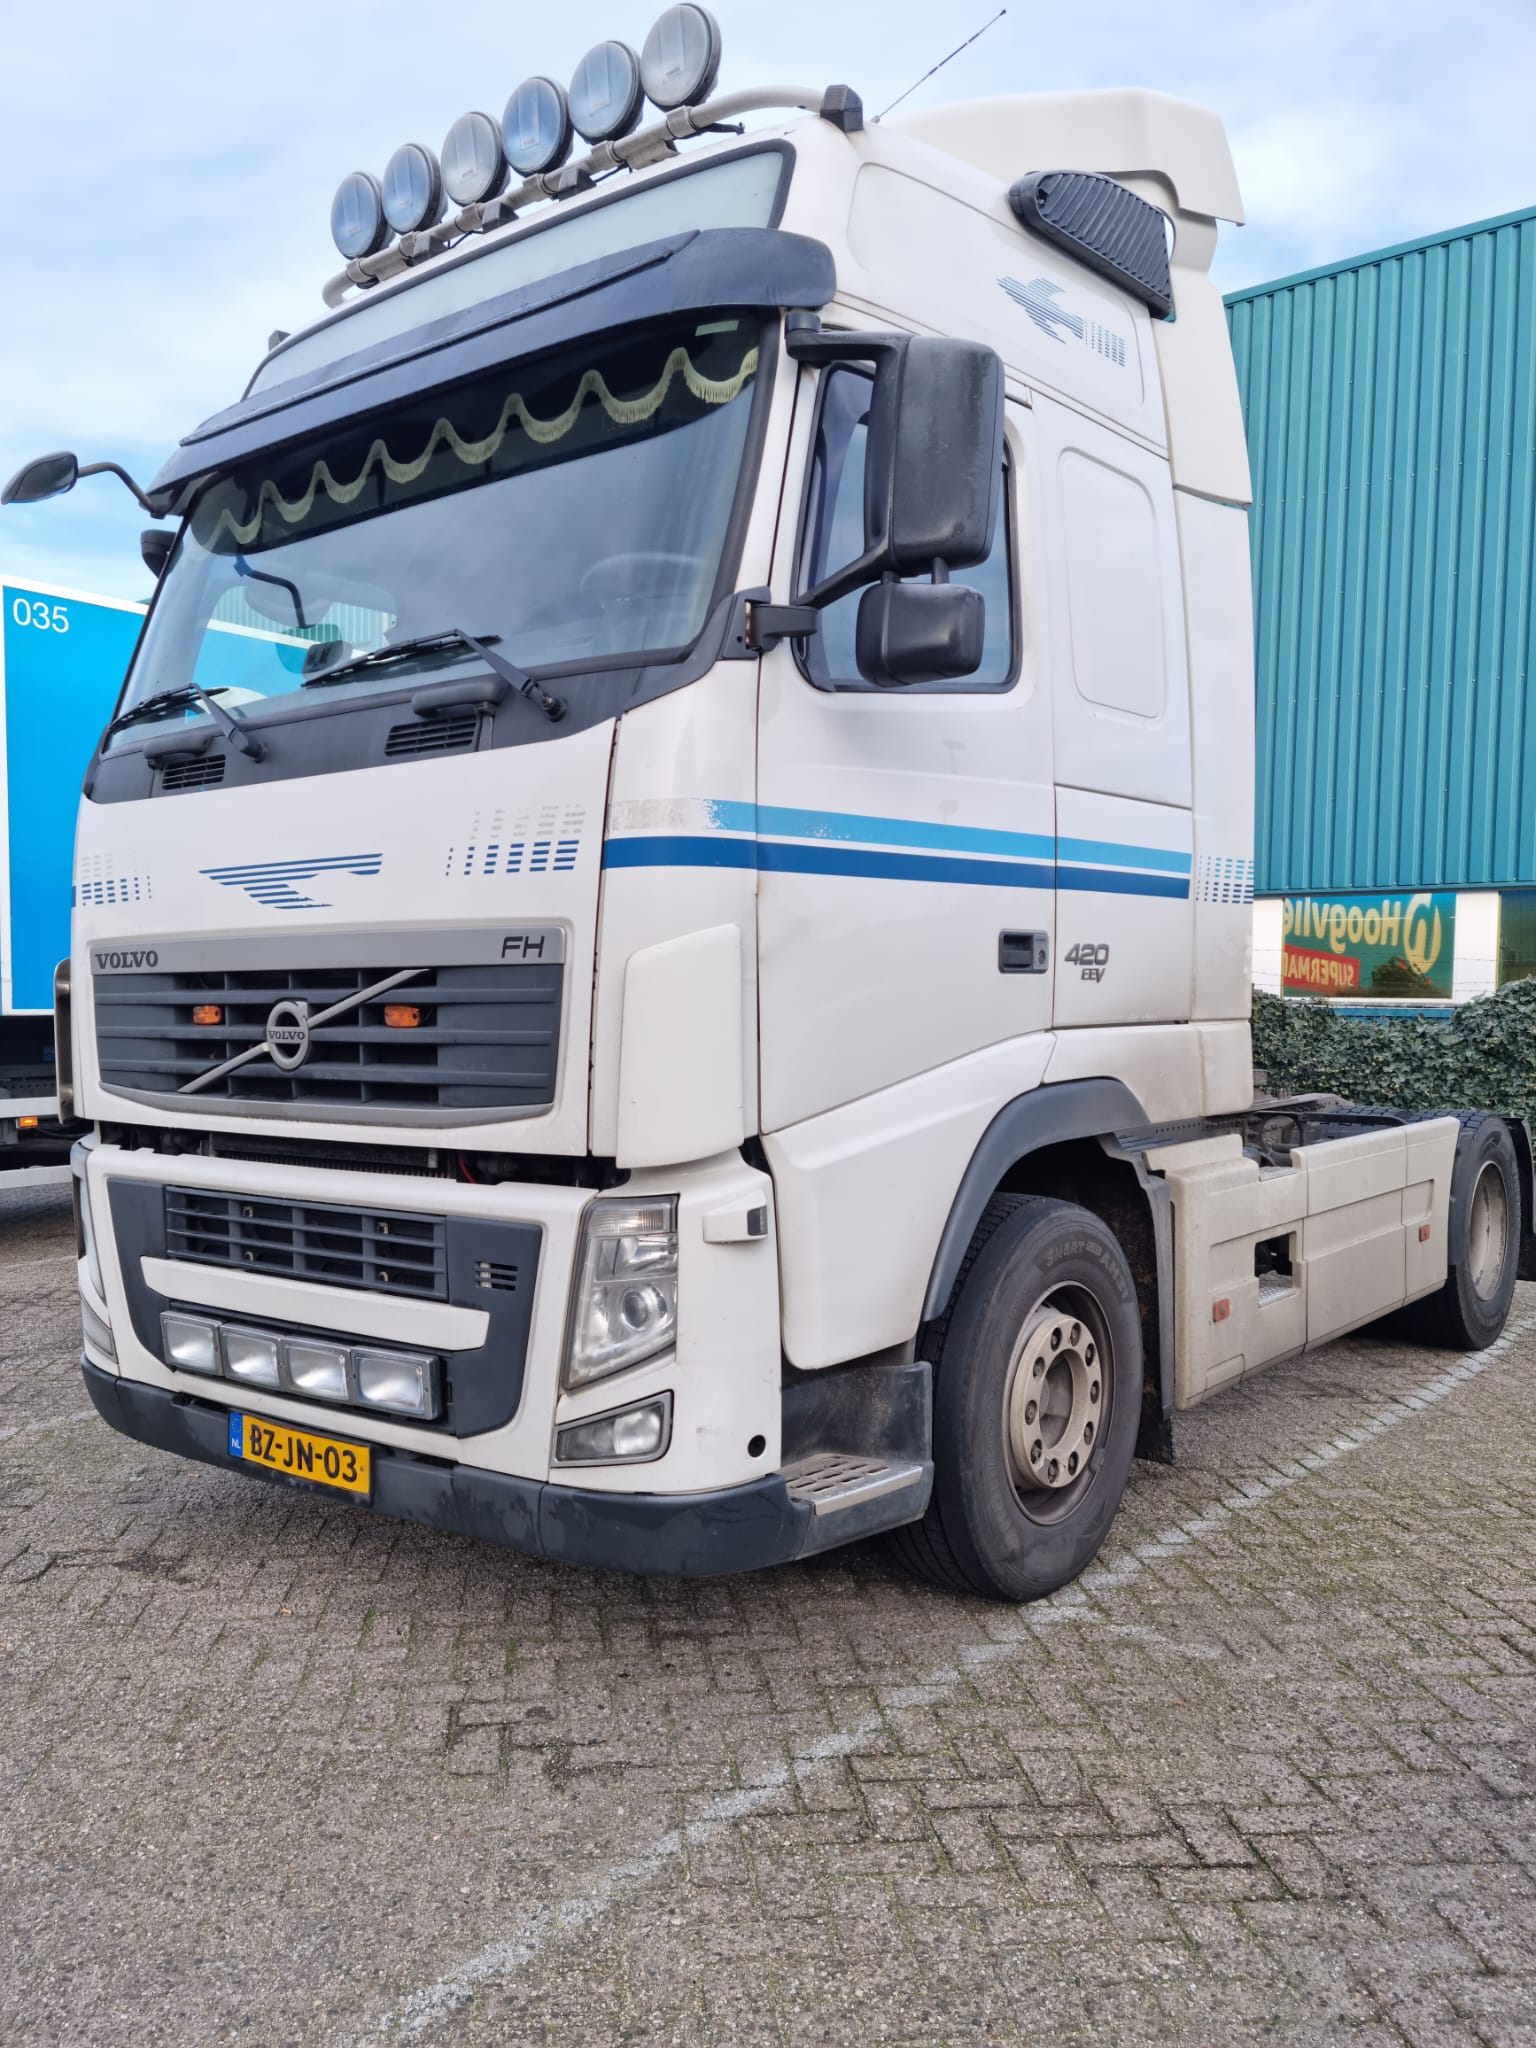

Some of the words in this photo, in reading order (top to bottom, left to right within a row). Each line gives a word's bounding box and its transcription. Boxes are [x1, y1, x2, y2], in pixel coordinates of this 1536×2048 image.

[13, 598, 69, 633] 035
[501, 935, 545, 959] FH
[1064, 943, 1110, 966] 420
[95, 950, 159, 970] VOLVO
[1081, 968, 1106, 984] EEV
[268, 1031, 306, 1040] VOLVO
[231, 1437, 241, 1449] NL
[250, 1424, 358, 1484] BZ-JN-03
